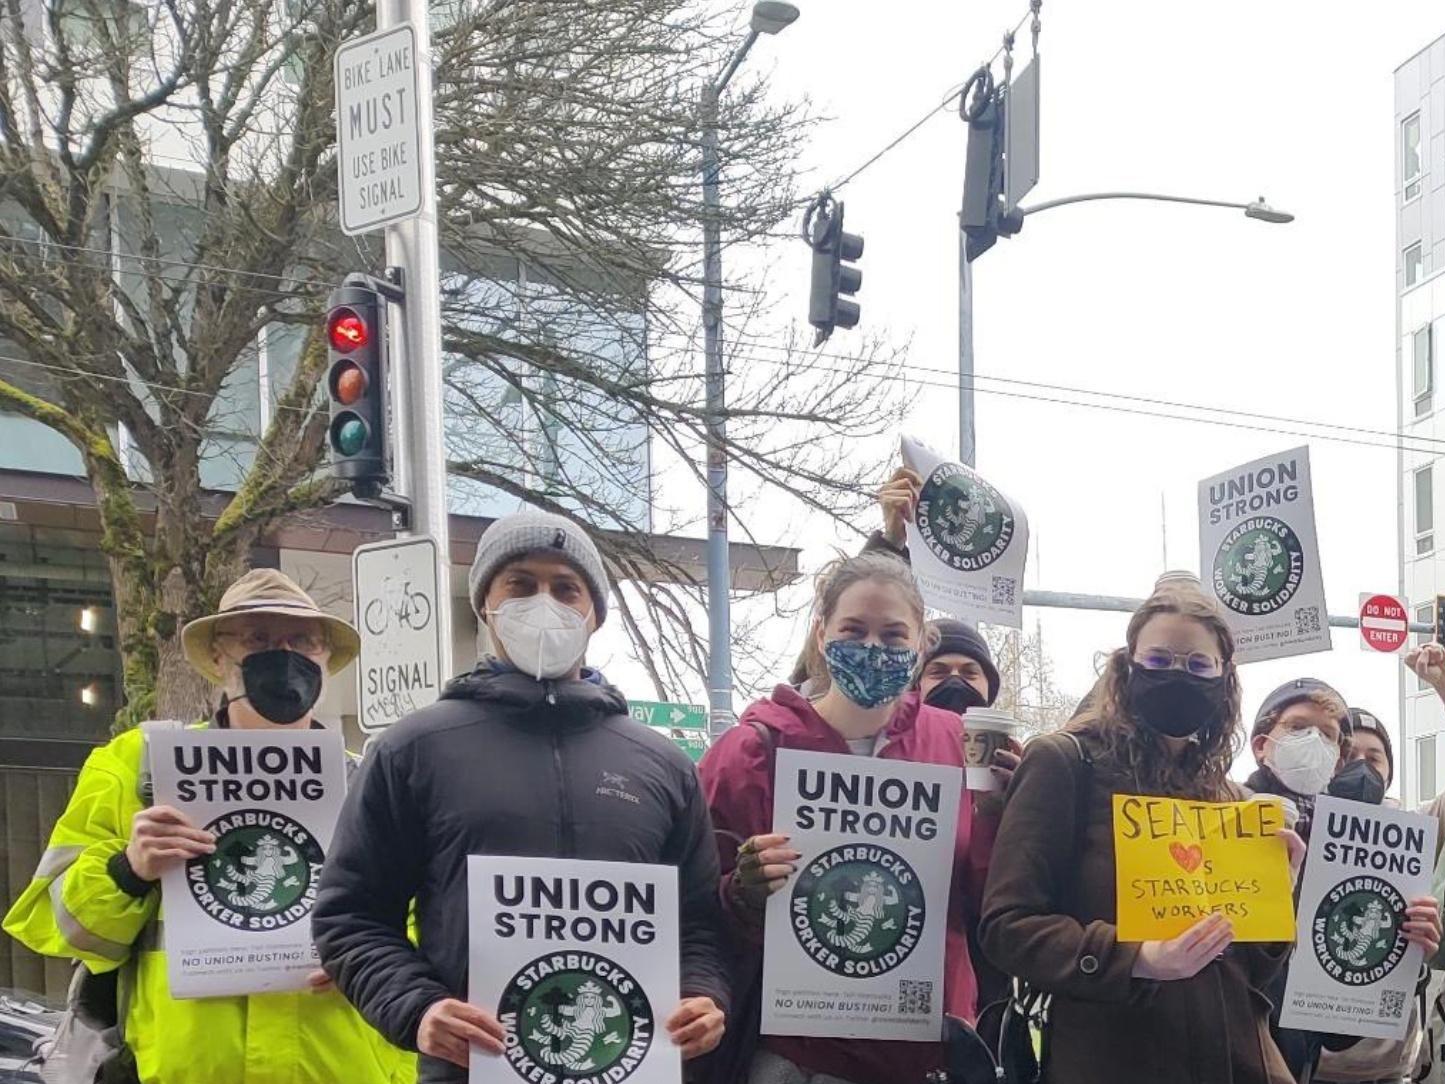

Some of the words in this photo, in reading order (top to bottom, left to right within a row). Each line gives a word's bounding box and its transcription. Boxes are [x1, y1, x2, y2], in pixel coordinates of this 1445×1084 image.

[344, 60, 371, 90] BIKE
[379, 47, 410, 78] LANE
[350, 88, 406, 140] MUST
[353, 151, 375, 179] USE
[381, 141, 407, 170] BIKE
[360, 175, 404, 209] SIGNAL
[1210, 460, 1297, 505] UNION
[1210, 485, 1298, 525] STRONG
[918, 501, 949, 561] WORKER
[953, 515, 1012, 570] SOLIDARITY
[1222, 518, 1288, 552] STARBUCKS
[1214, 568, 1248, 612] WORKER
[1252, 551, 1301, 613] SOLIDARITY
[1366, 604, 1380, 615] DO
[1384, 606, 1400, 617] NOT
[1370, 630, 1398, 642] ENTER
[368, 661, 434, 694] SIGNAL
[174, 746, 322, 774] UNION
[176, 779, 324, 802] STRONG
[797, 768, 942, 812] UNION
[207, 812, 308, 845] TARBUCKS
[796, 805, 938, 841] STRONG
[1122, 798, 1278, 840] SEATTLE
[1327, 812, 1425, 854] UNION
[810, 847, 912, 886] STARBUCKS
[1323, 841, 1422, 876] STRONG
[189, 864, 244, 928] WORKER
[494, 874, 655, 914] UNION
[1131, 878, 1261, 899] STARBUCKS
[1330, 878, 1404, 912] STARBUCKS
[494, 912, 656, 944] STRONG
[1152, 902, 1248, 920] WORKERS
[794, 896, 840, 969] WORKER
[844, 904, 922, 976] SOLIDARITY
[1315, 917, 1342, 978] WORKER
[182, 958, 200, 967] NO
[204, 956, 243, 966] UNION
[516, 954, 634, 995] STARBUCKS
[775, 999, 794, 1008] NO
[796, 1000, 835, 1010] UNION
[838, 1002, 892, 1013] BUSTING!
